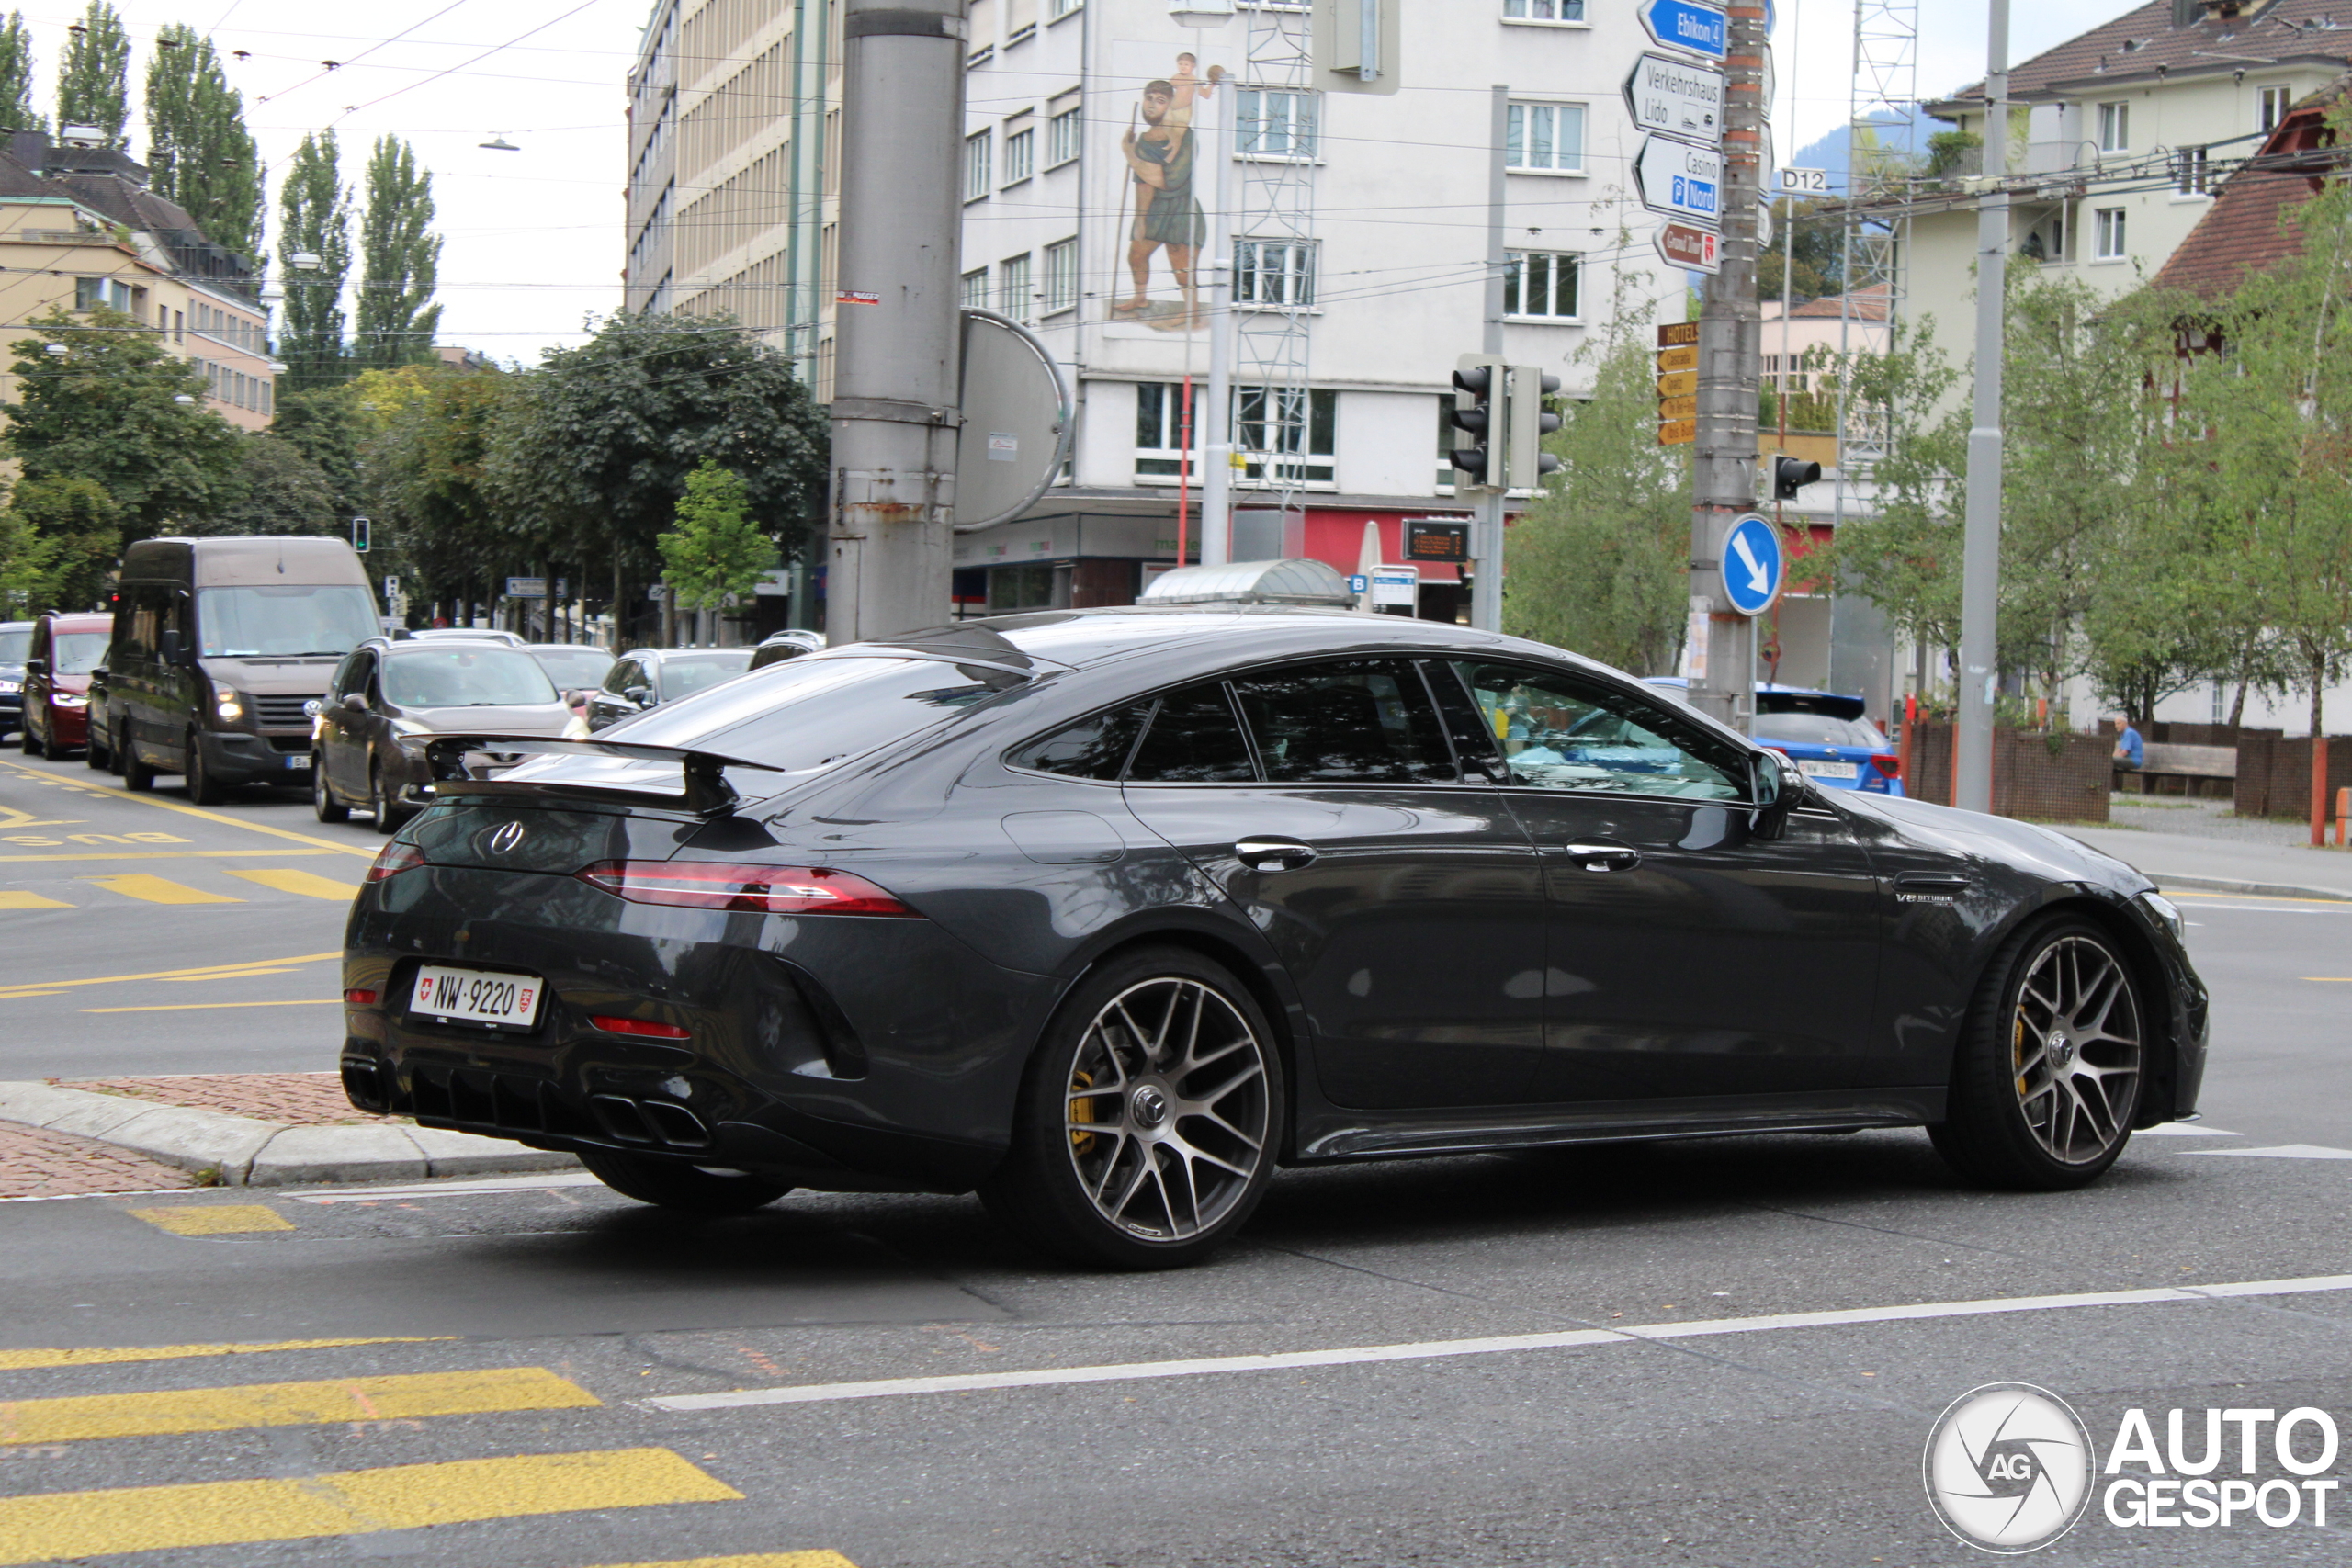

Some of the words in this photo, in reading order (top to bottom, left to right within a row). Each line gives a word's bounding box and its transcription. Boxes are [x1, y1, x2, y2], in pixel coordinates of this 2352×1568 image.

[1678, 12, 1711, 43] Ebikon
[1713, 23, 1720, 44] 4
[1647, 64, 1718, 103] Verkehrshaus
[1645, 97, 1668, 125] Lido
[1685, 151, 1716, 180] Casino
[1782, 172, 1825, 190] D12
[1689, 181, 1714, 210] Nord
[1667, 231, 1687, 252] Grand
[1352, 577, 1365, 591] B
[1, 832, 196, 847] BUS
[1895, 893, 1917, 903] V8
